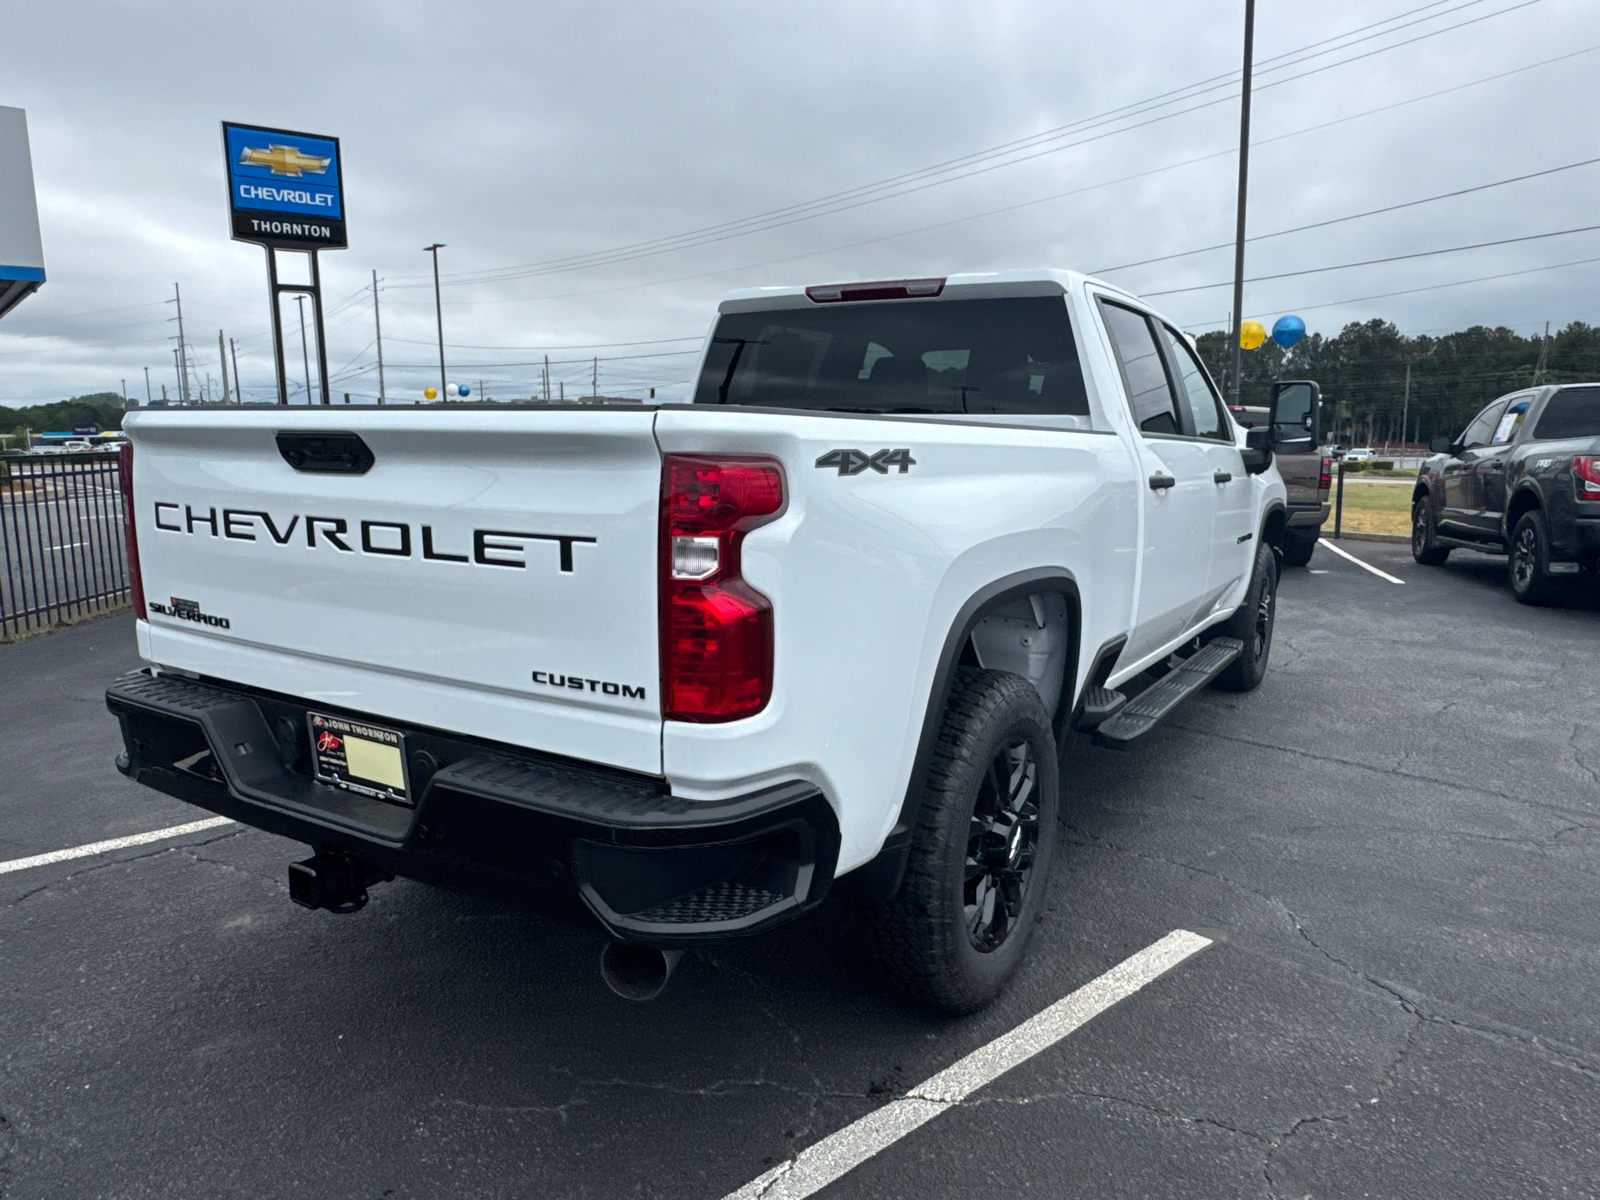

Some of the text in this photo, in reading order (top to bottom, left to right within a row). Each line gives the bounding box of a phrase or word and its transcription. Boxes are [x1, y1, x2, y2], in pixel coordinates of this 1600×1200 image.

[240, 184, 334, 206] CHEVROLET
[251, 219, 331, 238] THORNTON
[155, 502, 597, 572] CHEVROLET
[149, 601, 230, 629] SILVERADO
[532, 670, 646, 699] CUSTOM
[328, 719, 350, 731] JOHN
